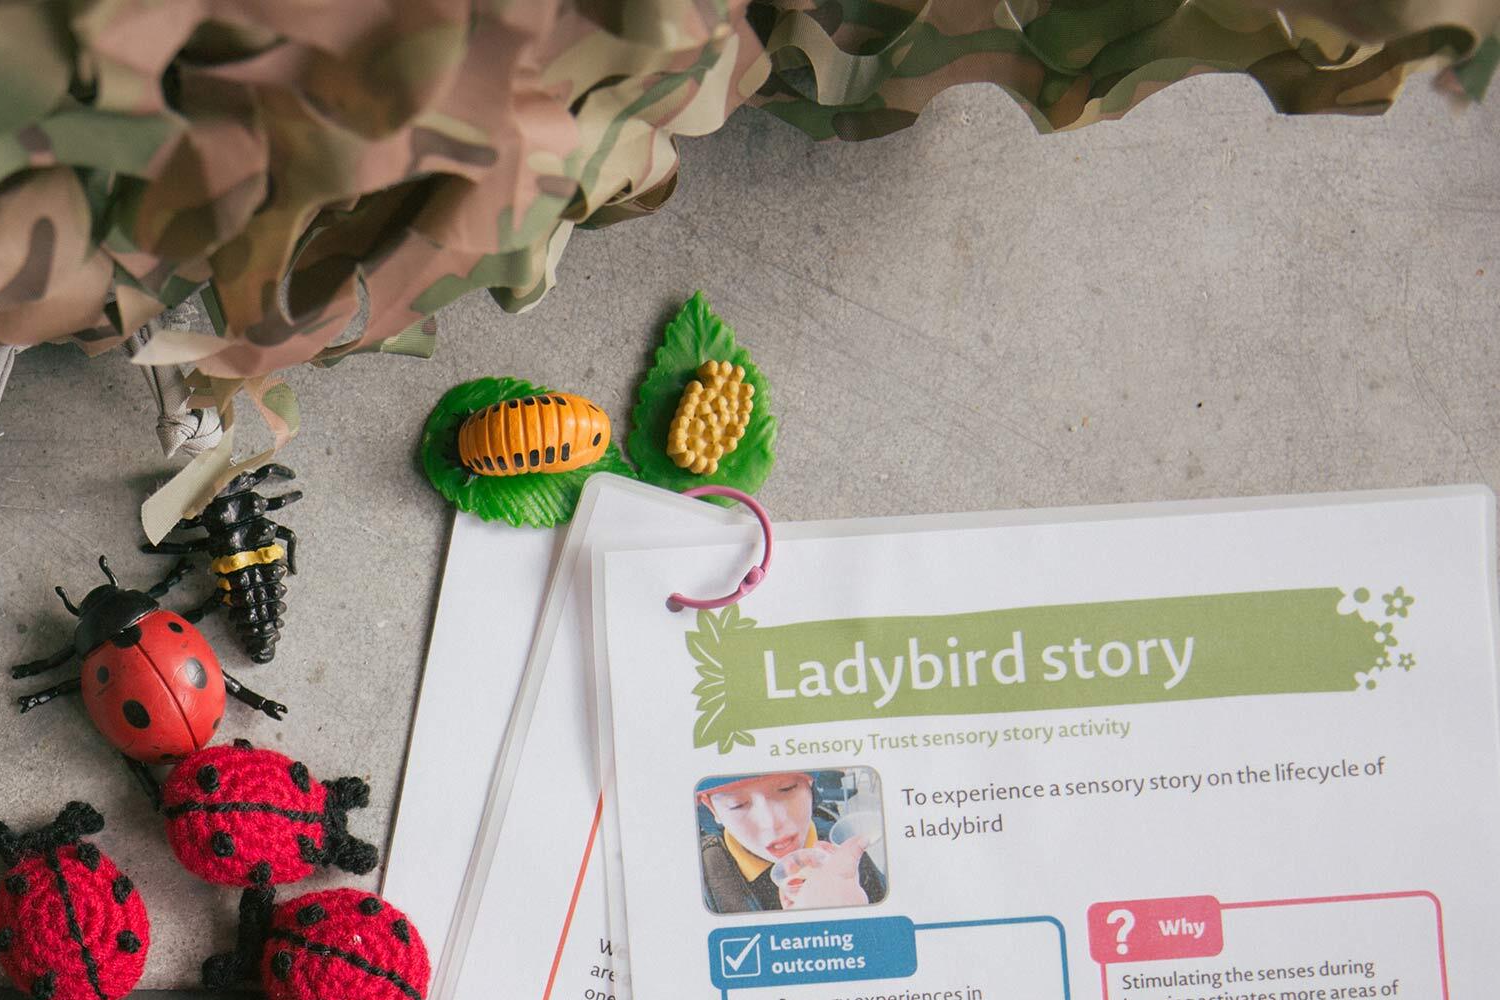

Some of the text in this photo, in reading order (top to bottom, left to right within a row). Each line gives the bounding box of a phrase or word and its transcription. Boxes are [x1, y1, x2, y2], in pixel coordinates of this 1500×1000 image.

[764, 630, 1194, 709] Ladybird story
[770, 718, 1130, 757] a Sensory Trust sensory story activity
[901, 756, 1385, 808] To experience a sensory story on the lifecycle of
[905, 813, 1003, 840] a ladybird
[770, 930, 854, 951] Learning
[1158, 917, 1205, 939] Why
[772, 956, 866, 974] outcomes
[1122, 959, 1375, 990] Stimulating the senses during
[967, 985, 982, 1000] in
